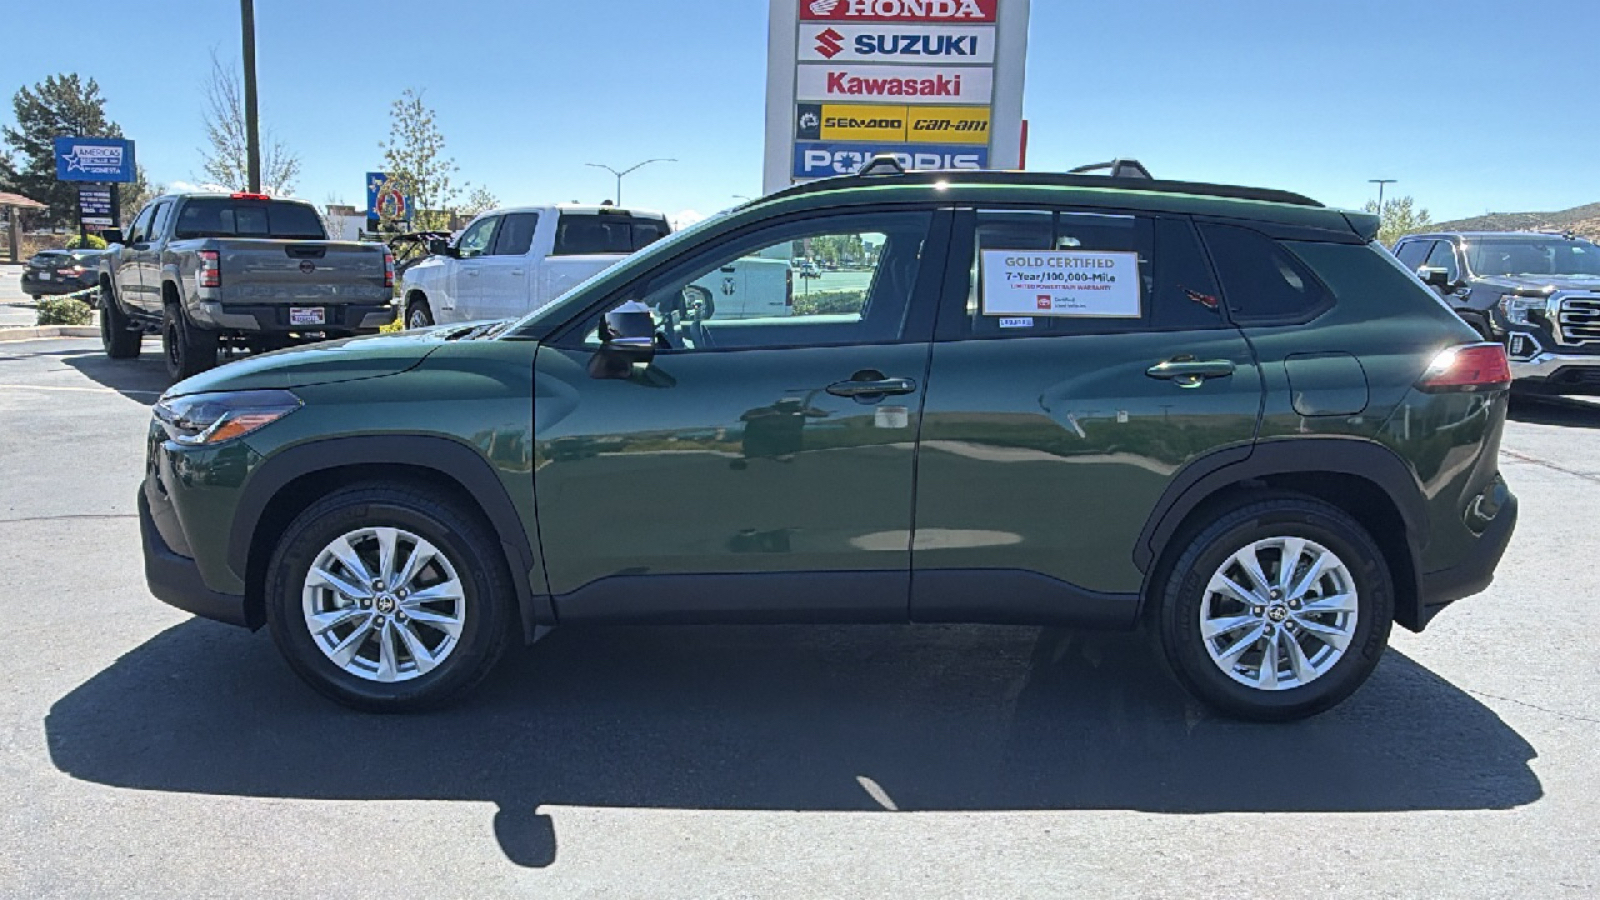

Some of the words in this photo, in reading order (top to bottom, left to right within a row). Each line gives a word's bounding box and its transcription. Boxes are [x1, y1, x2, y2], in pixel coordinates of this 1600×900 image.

[845, 0, 985, 18] HONDA
[854, 34, 977, 56] SUZUKI
[827, 72, 961, 96] Kawasaki
[1005, 257, 1045, 267] GOLD
[1047, 257, 1115, 268] CERTIFIED
[1005, 272, 1116, 283] 7-Year/100,000-Mile
